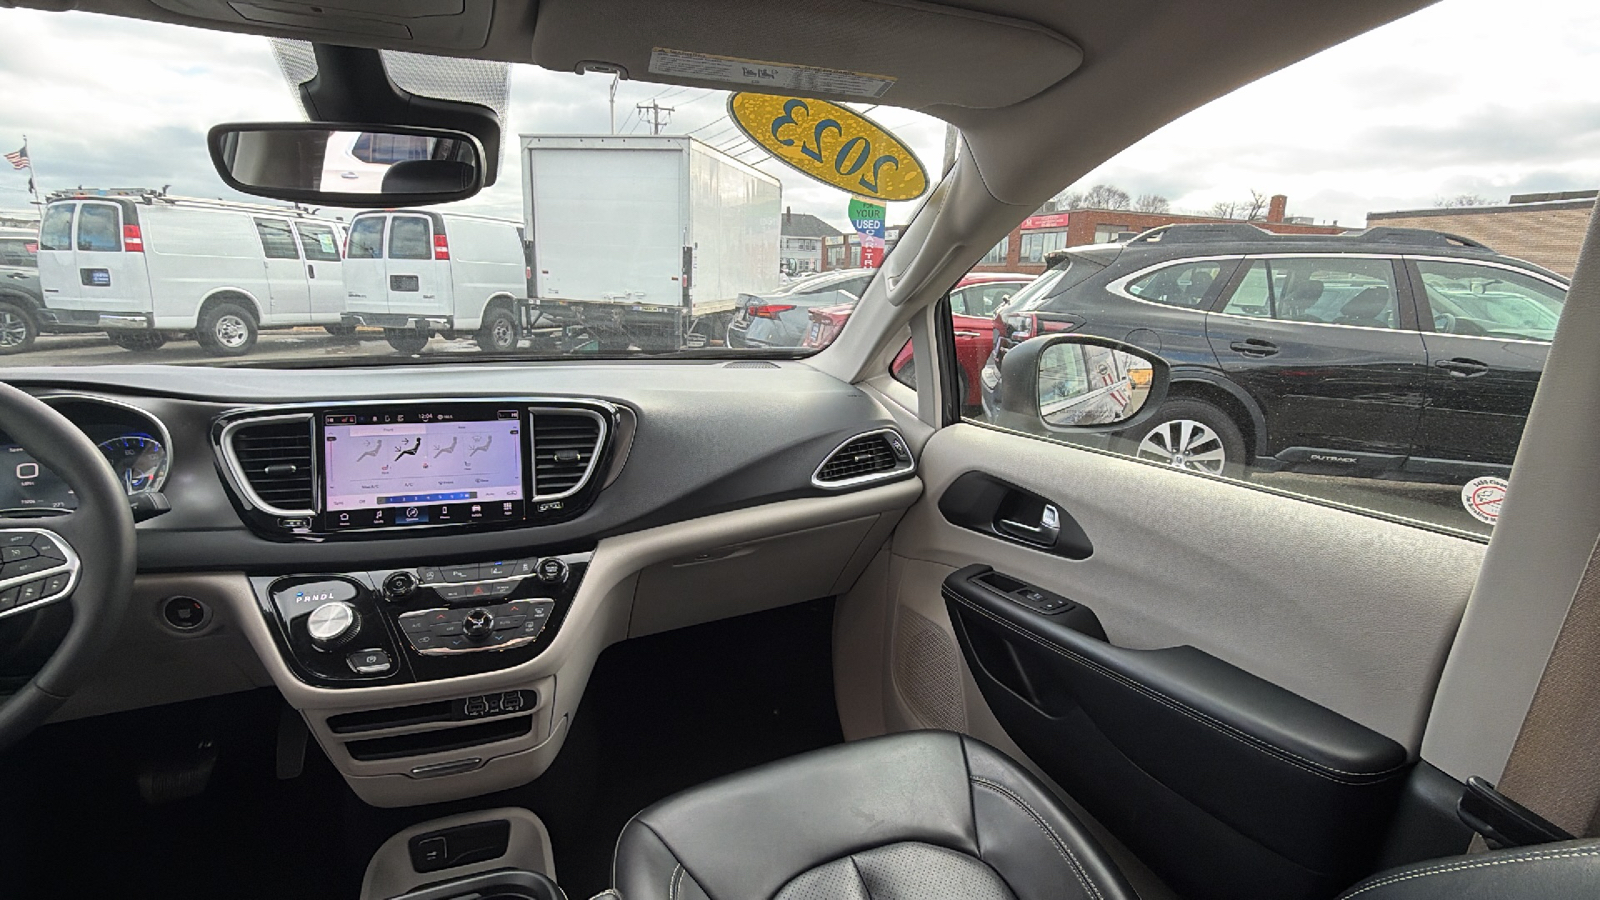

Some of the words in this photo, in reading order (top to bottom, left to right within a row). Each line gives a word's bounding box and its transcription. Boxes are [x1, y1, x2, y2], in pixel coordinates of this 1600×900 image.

[856, 209, 881, 218] YOUR
[856, 219, 881, 229] USED
[1310, 454, 1358, 464] OUTBACK
